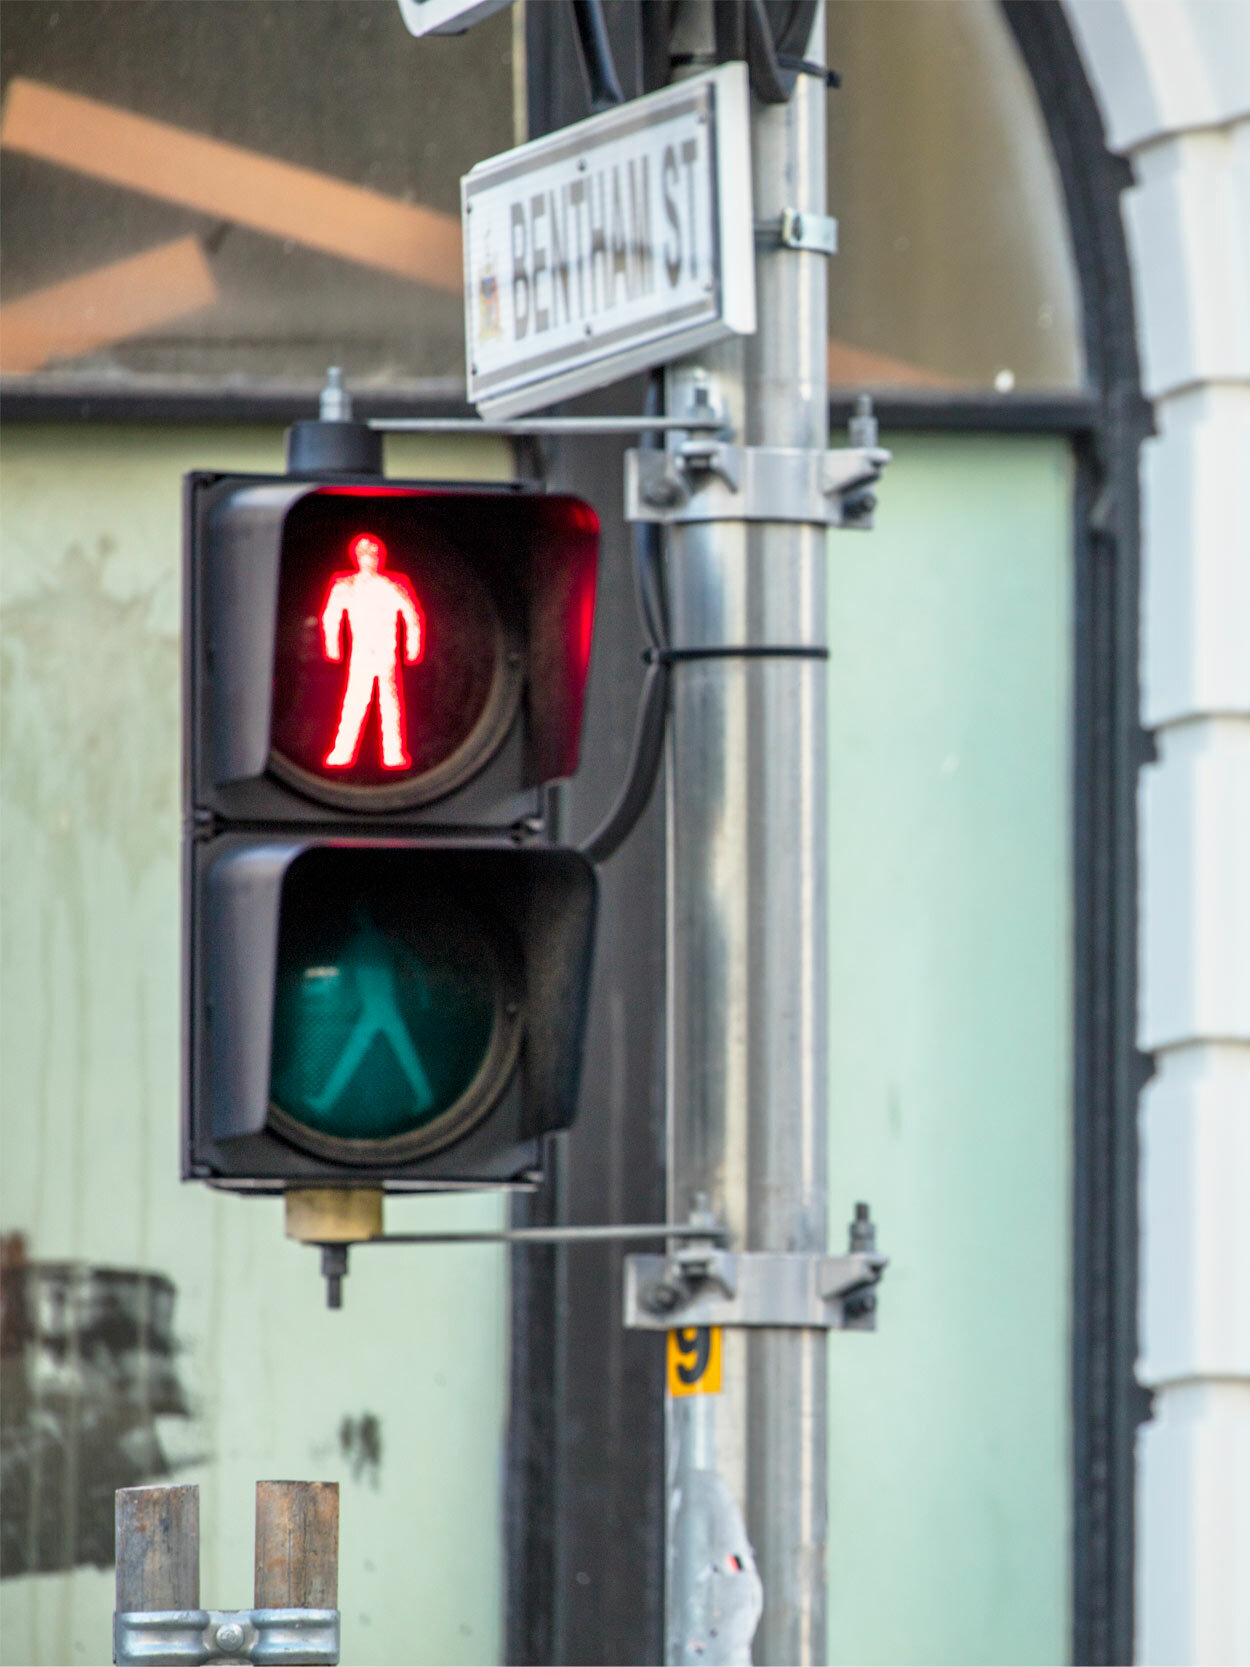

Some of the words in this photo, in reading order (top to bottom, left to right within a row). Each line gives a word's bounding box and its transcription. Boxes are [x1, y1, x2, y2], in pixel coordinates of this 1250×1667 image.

[511, 154, 655, 341] BENTHAM
[662, 137, 698, 289] ST
[676, 1326, 711, 1384] 9
